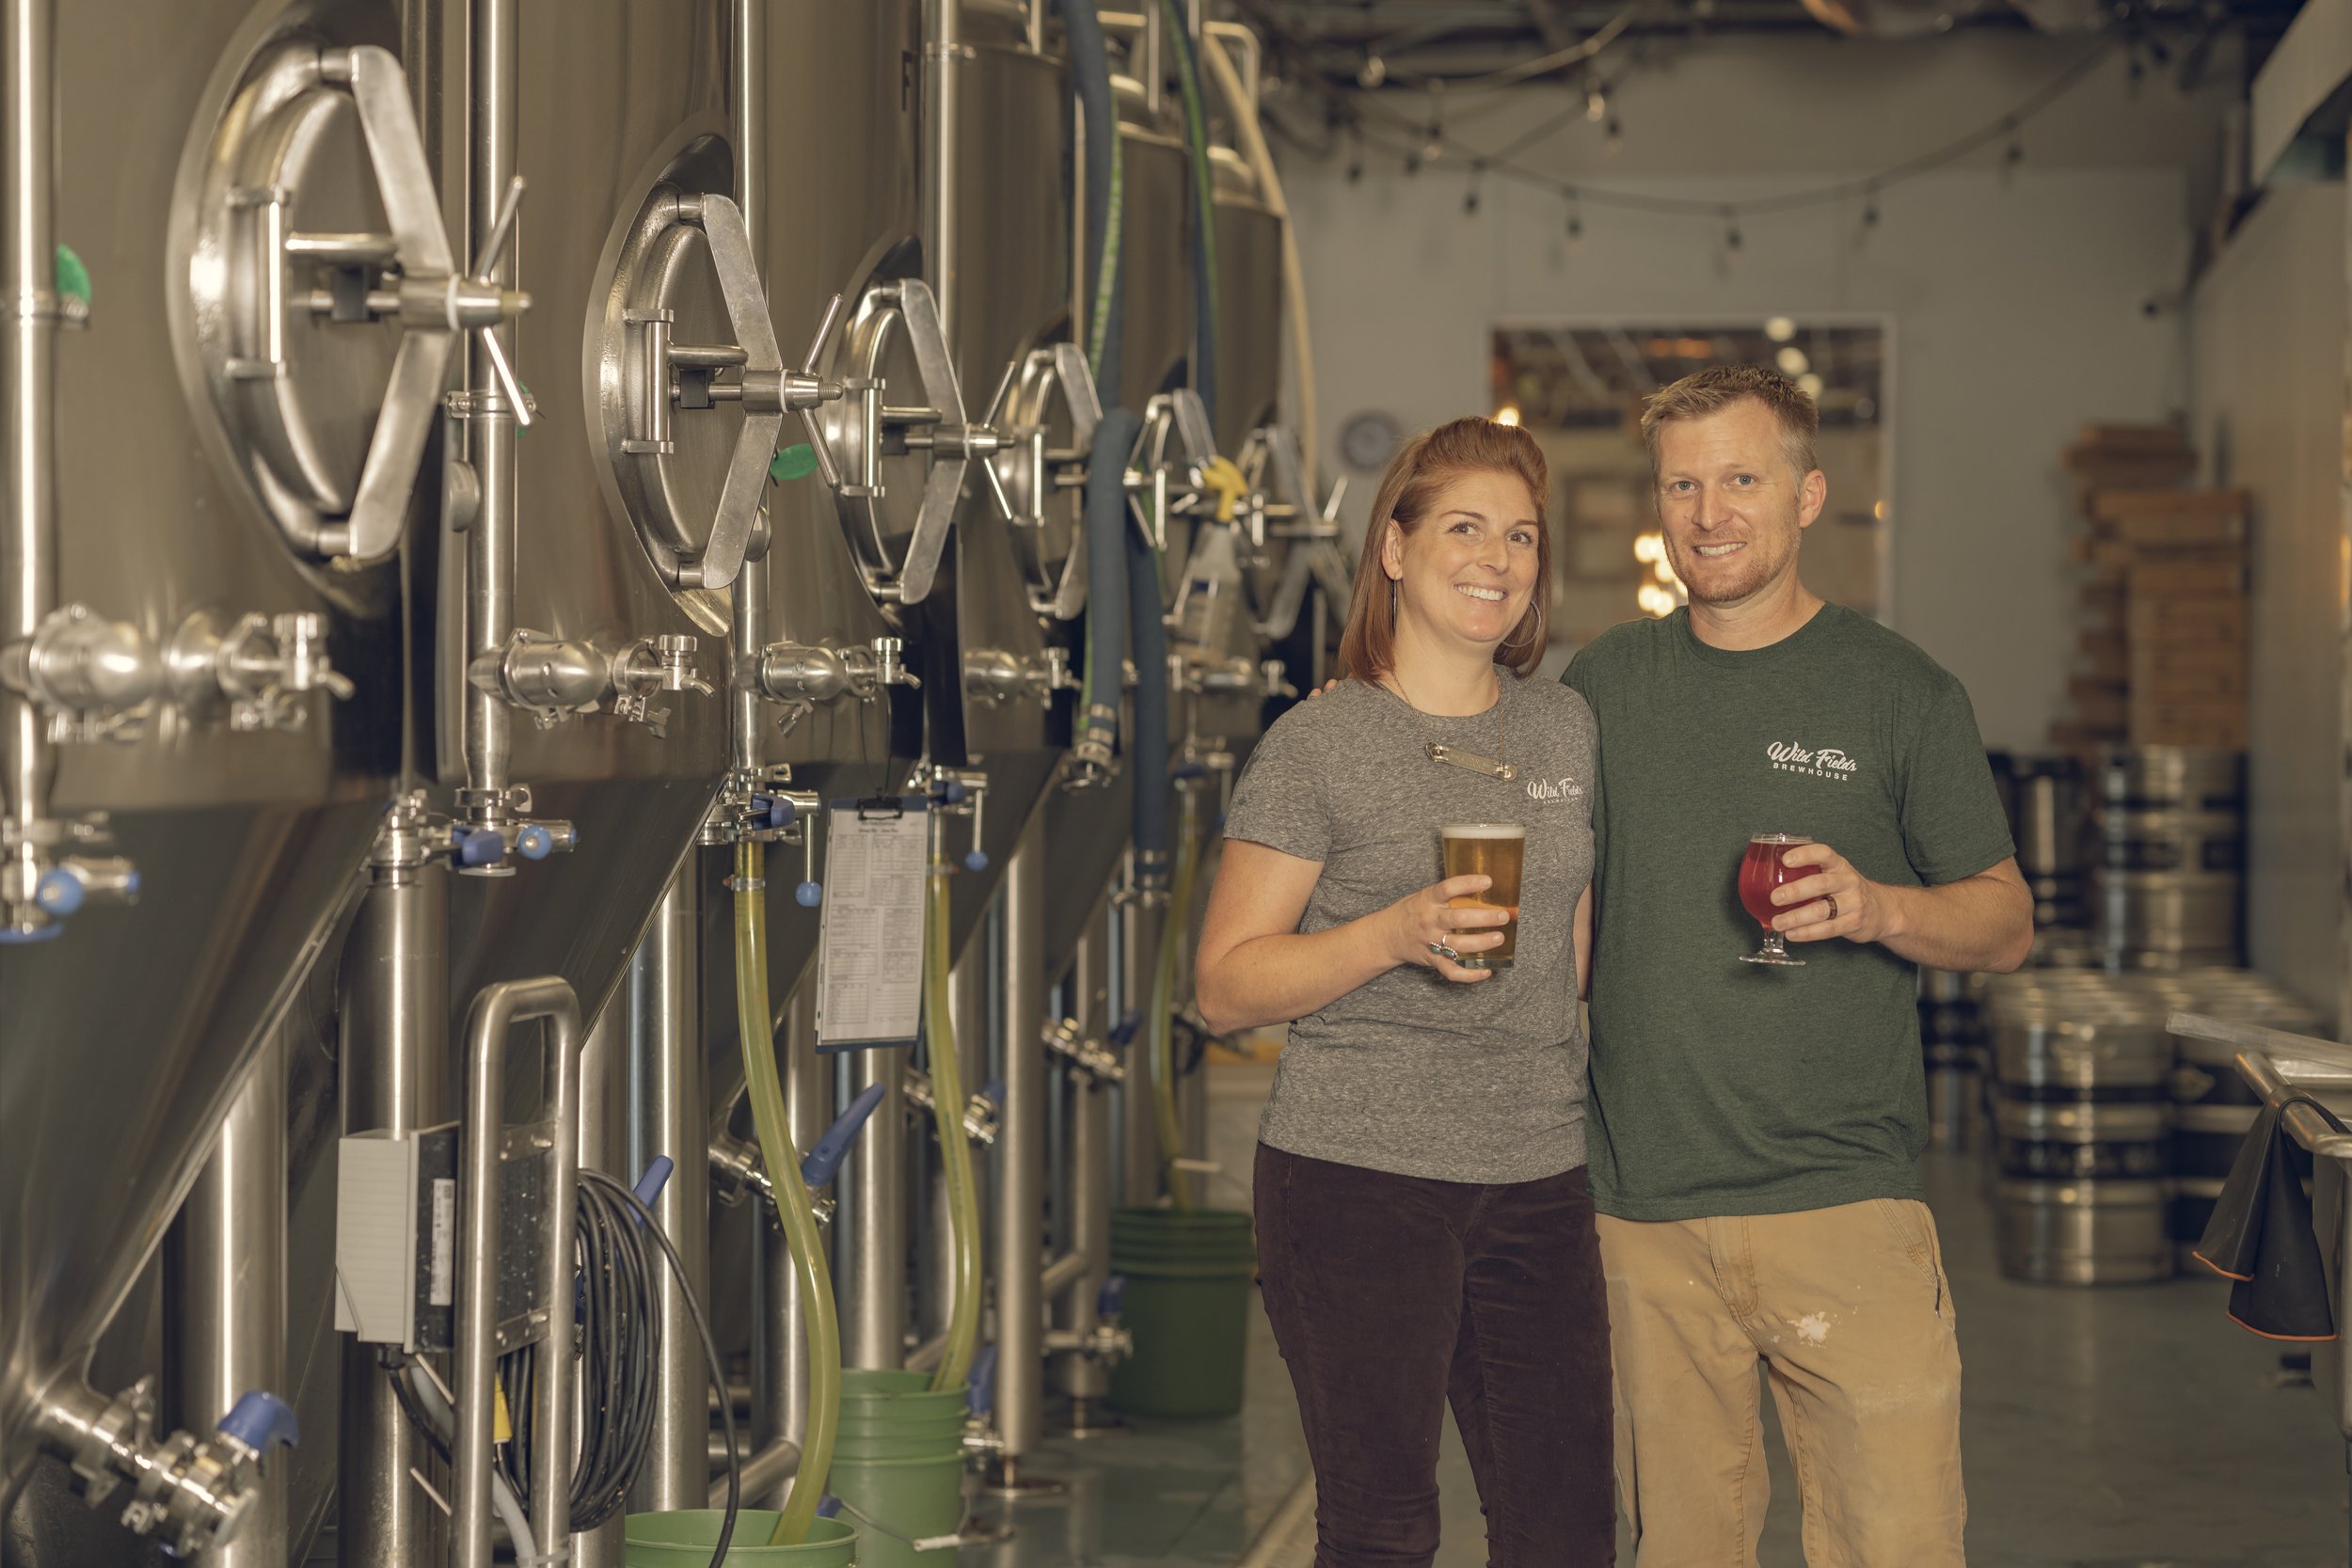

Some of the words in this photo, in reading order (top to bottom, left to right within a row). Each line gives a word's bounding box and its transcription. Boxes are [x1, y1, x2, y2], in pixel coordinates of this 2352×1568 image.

[1767, 741, 1814, 763] Wild
[1816, 749, 1857, 771] Fields
[1772, 762, 1848, 781] BREWHOUSE
[1527, 778, 1559, 799] Wild
